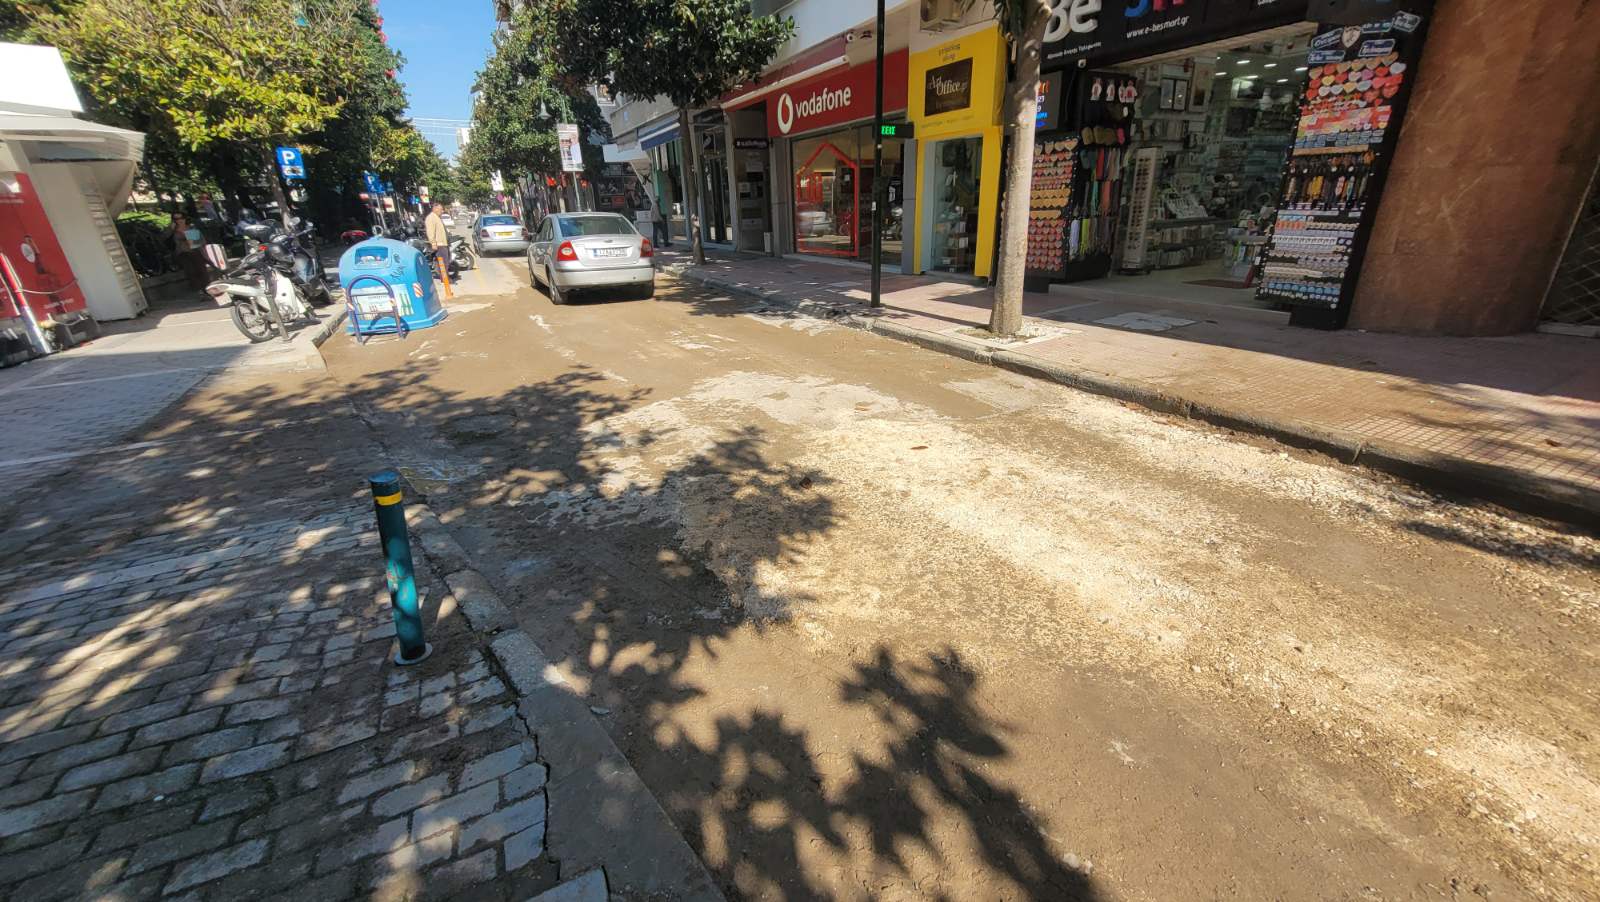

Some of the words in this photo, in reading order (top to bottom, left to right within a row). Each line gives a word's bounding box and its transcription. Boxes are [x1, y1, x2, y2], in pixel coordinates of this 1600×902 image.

[1126, 16, 1190, 39] www.e-besmart.gr
[795, 86, 852, 119] vodafone
[282, 150, 295, 164] P
